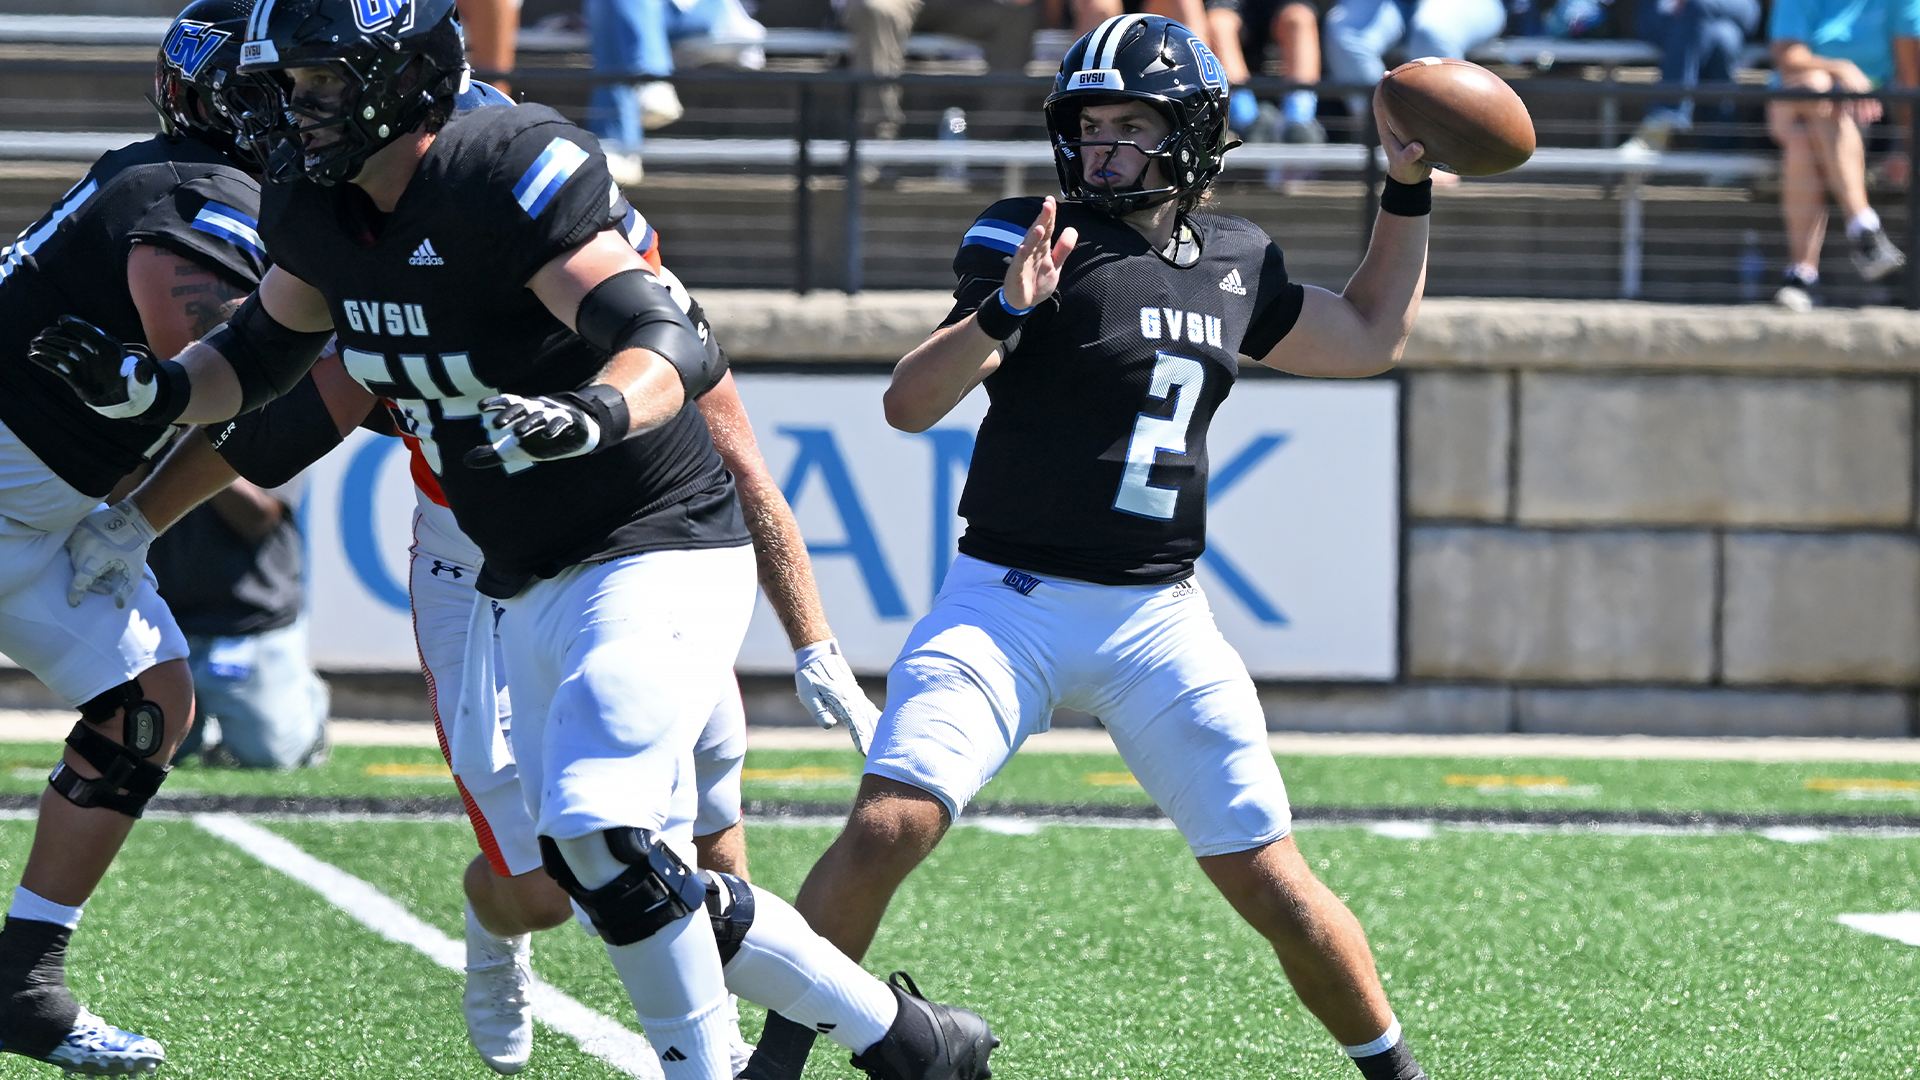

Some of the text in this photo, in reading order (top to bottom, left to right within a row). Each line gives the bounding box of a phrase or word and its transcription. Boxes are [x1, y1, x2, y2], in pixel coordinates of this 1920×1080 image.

[164, 19, 234, 82] GV
[1079, 72, 1106, 84] GVSU
[408, 255, 445, 266] adidas
[1218, 281, 1247, 296] adidas
[343, 299, 430, 337] GVSU
[1139, 306, 1223, 350] GVSU
[1110, 350, 1207, 523] 2
[1002, 568, 1043, 596] GV
